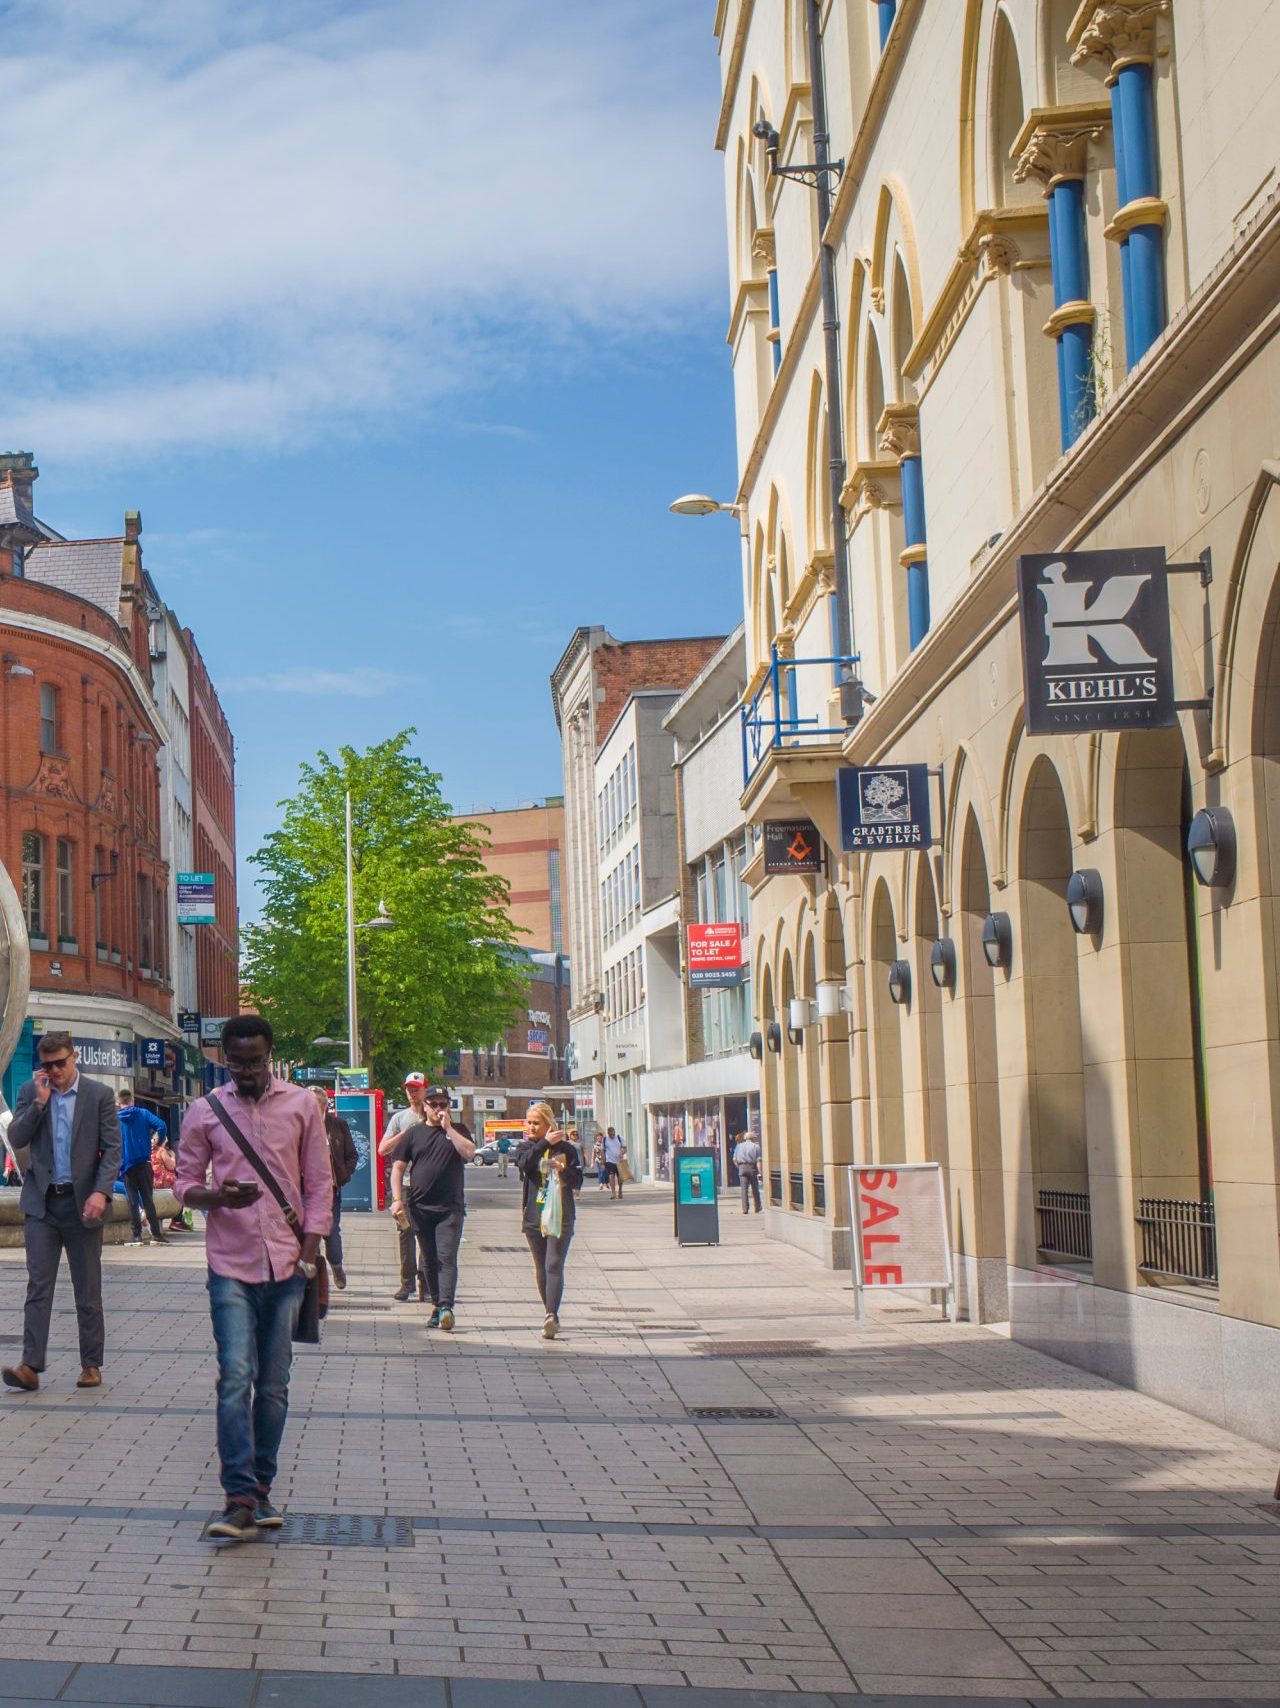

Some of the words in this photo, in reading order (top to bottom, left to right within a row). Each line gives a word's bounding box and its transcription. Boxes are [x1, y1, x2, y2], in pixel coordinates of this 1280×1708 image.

[1047, 676, 1158, 700] KIEHL'S
[1054, 711, 1102, 722] SINCE
[1114, 710, 1151, 720] 1851
[767, 832, 783, 840] Hall
[852, 825, 920, 836] CRABTREE
[852, 837, 862, 845] &
[867, 834, 921, 845] EVELYN
[704, 948, 720, 956] LET
[83, 1046, 110, 1066] Ulster
[111, 1049, 128, 1067] Bank
[860, 1169, 903, 1285] SALE
